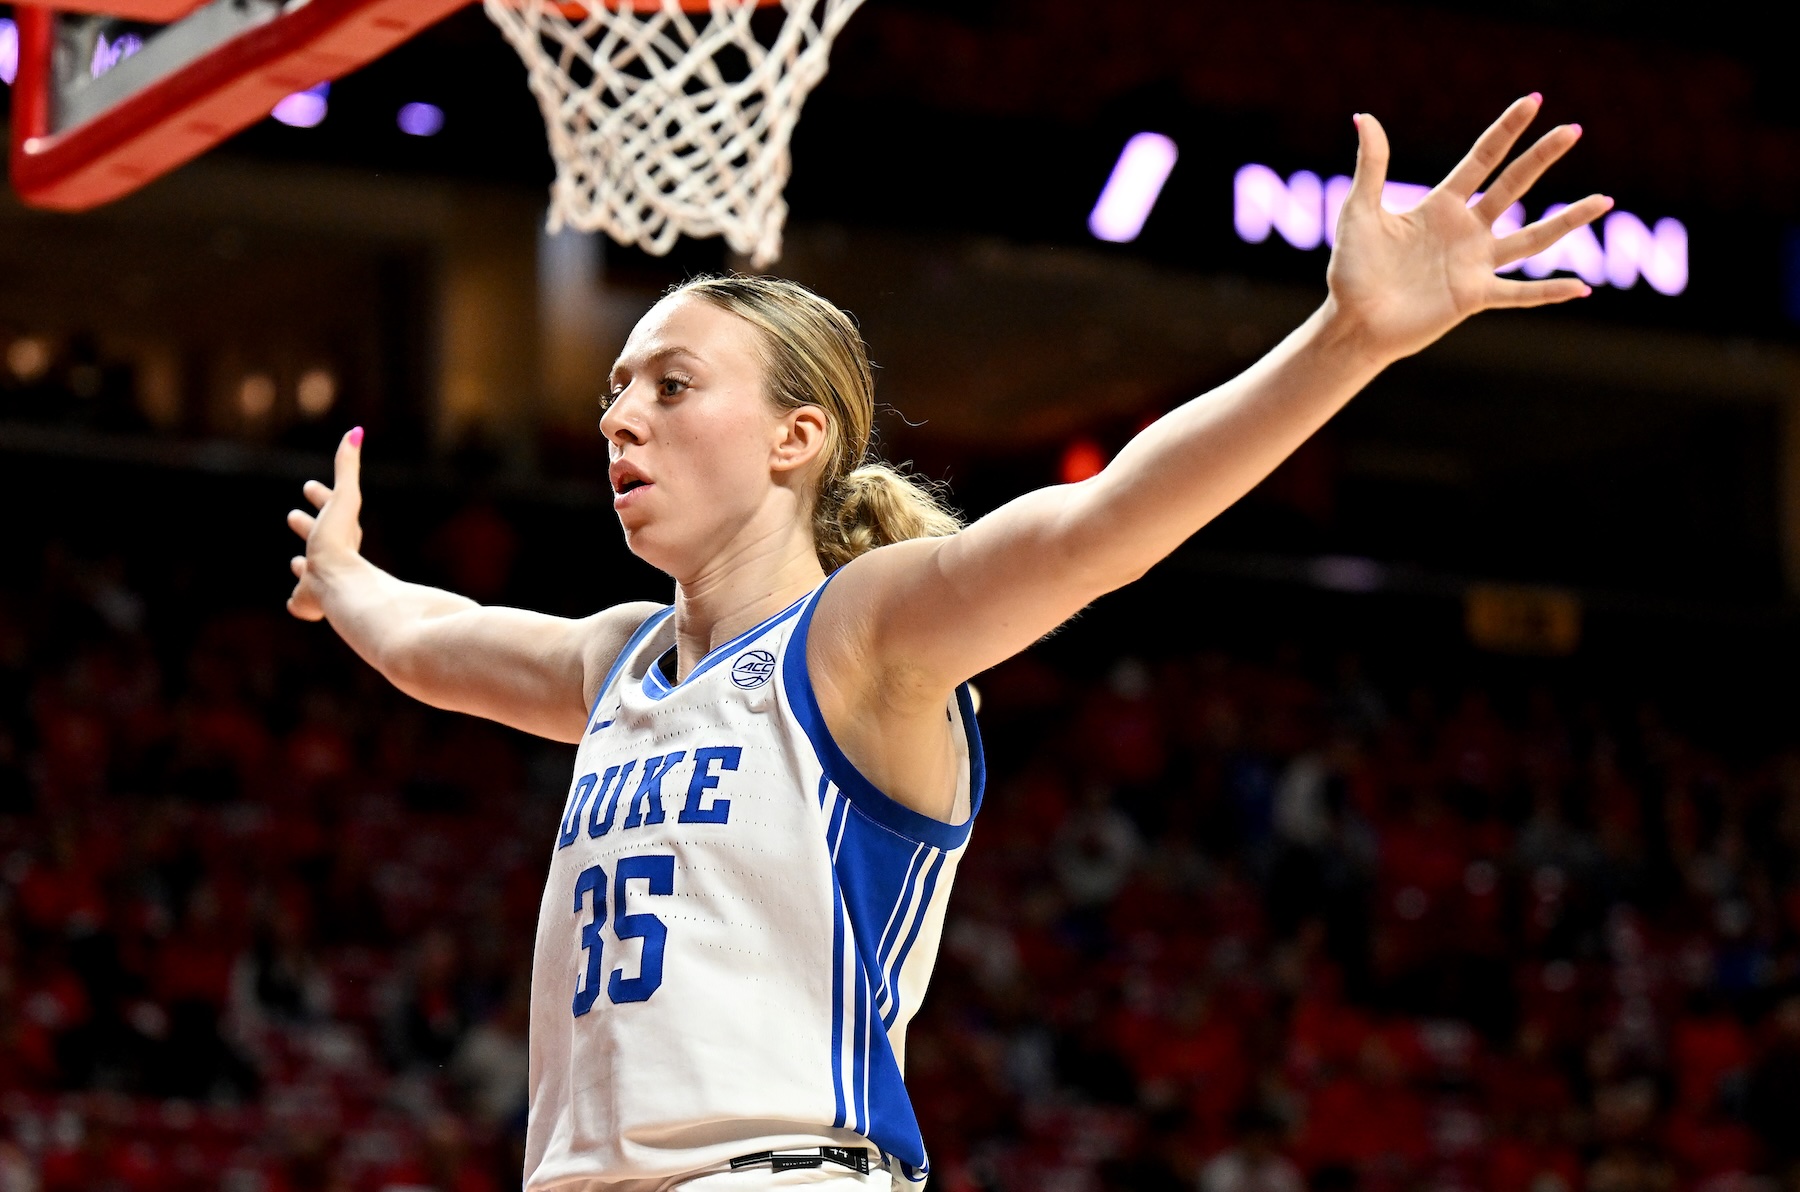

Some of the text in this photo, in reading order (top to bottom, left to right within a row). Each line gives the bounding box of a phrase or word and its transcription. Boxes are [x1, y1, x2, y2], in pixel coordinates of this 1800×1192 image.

[1234, 163, 1689, 296] NIAN
[737, 662, 775, 672] ACC
[558, 746, 743, 851] DUKE
[573, 855, 675, 1018] 35
